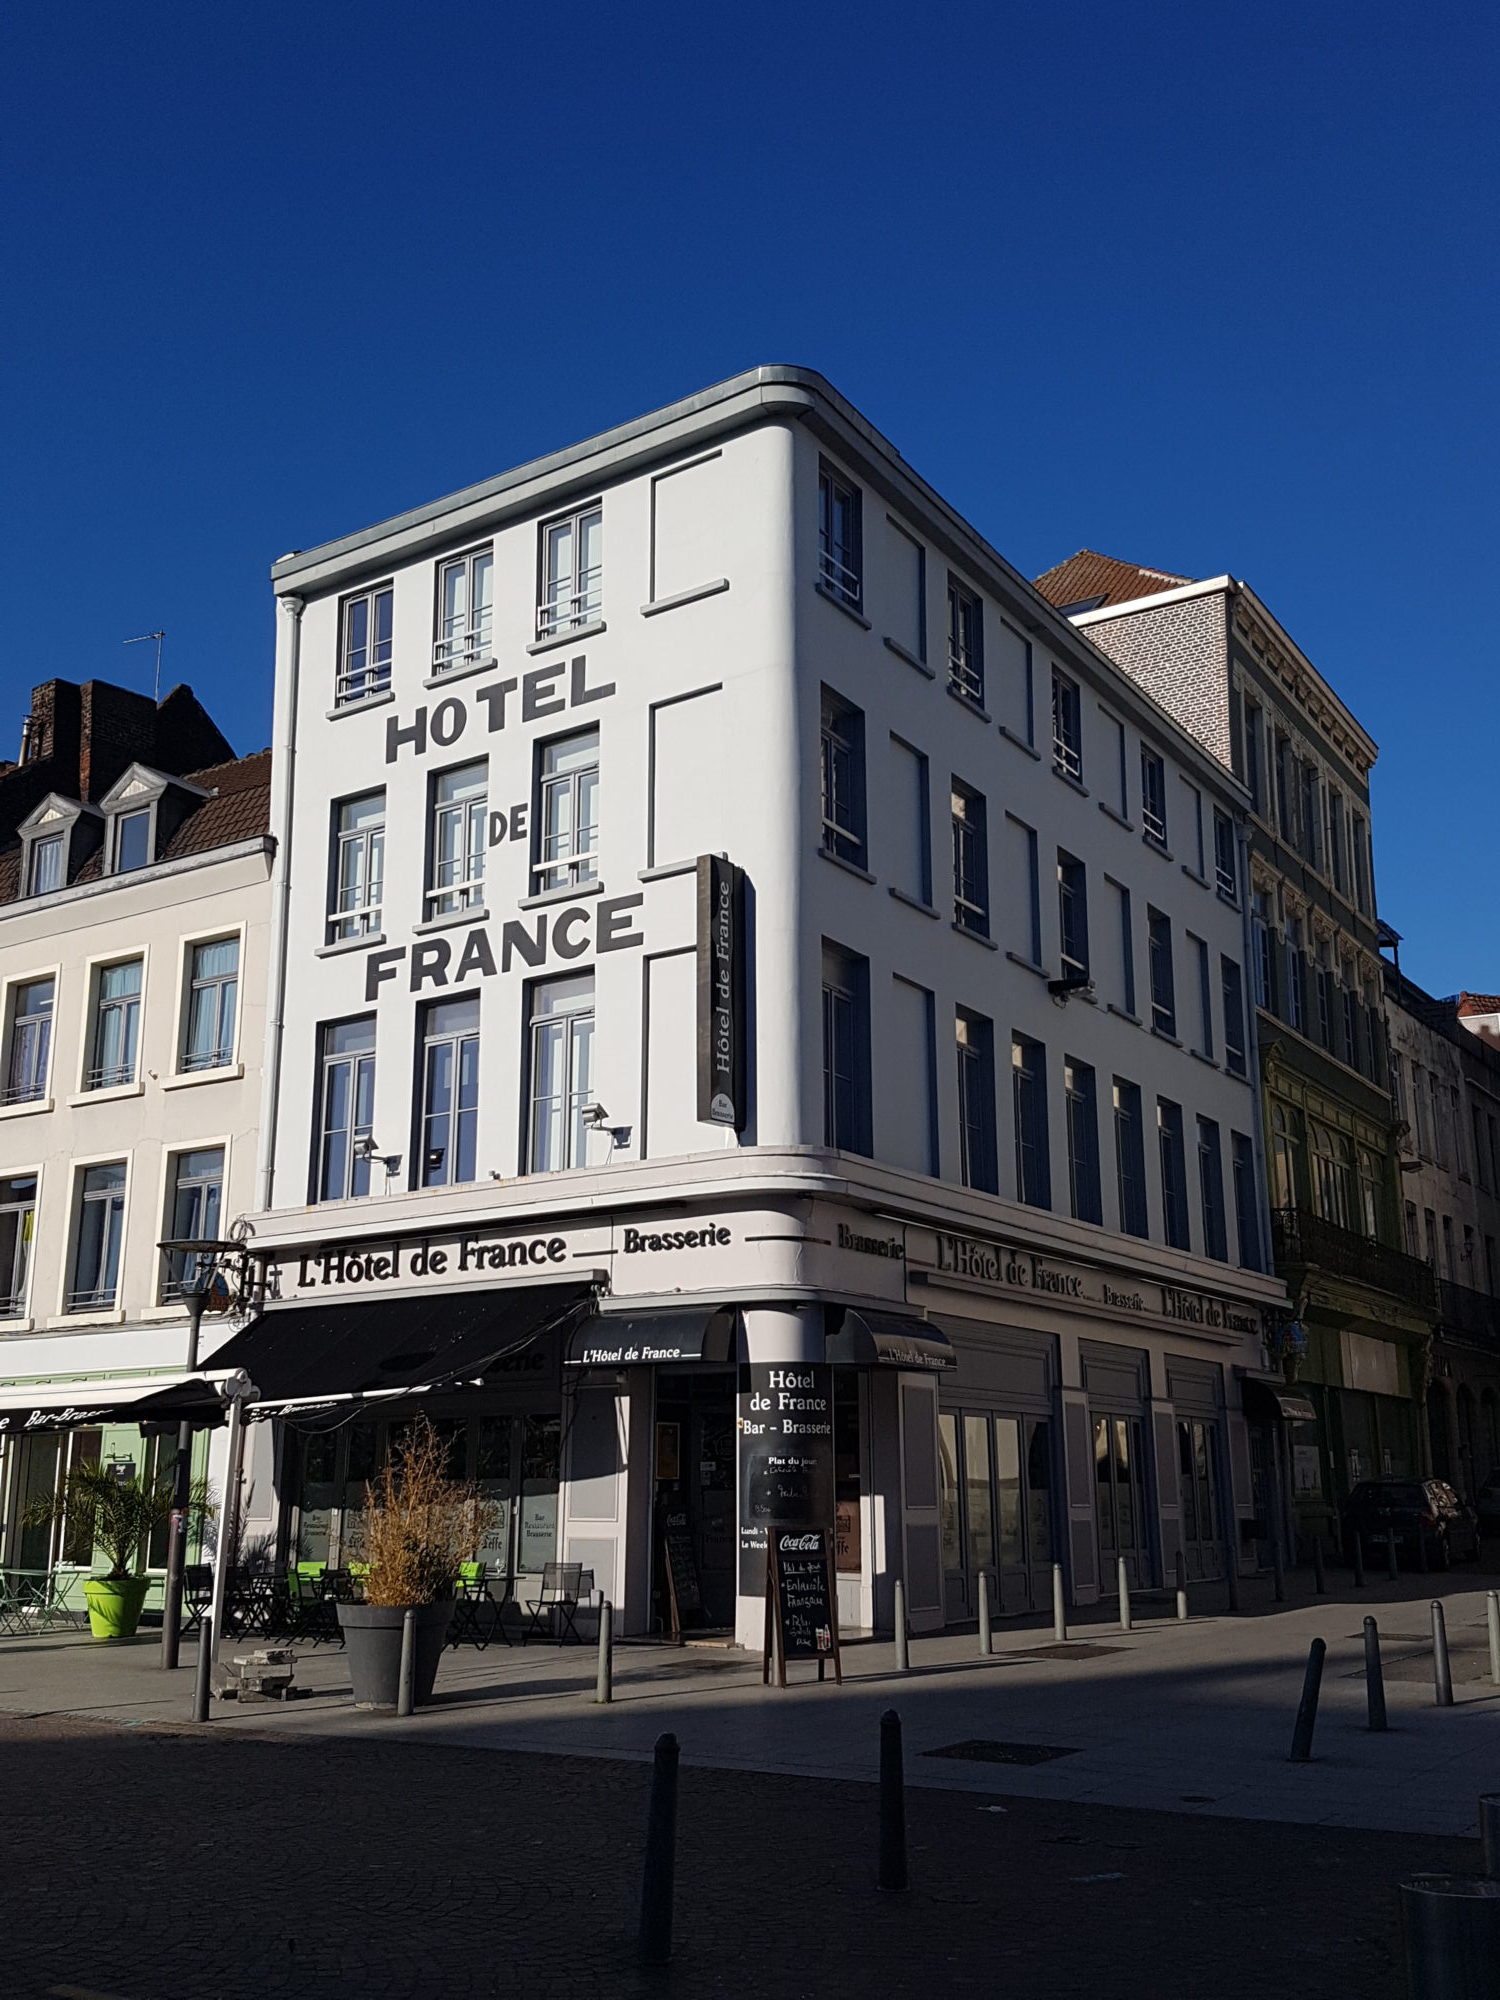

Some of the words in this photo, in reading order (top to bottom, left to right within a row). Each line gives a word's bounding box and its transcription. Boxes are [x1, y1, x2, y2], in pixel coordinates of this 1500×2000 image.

[386, 654, 616, 765] HOTEL
[488, 802, 529, 848] DE
[715, 880, 730, 961] France
[365, 892, 644, 1002] FRANCE
[715, 969, 730, 998] de
[715, 1007, 730, 1074] Hôtel
[622, 1221, 732, 1254] Brasserie
[837, 1222, 905, 1260] Brasserie
[297, 1240, 400, 1289] L'Hôtel
[410, 1239, 448, 1276] de
[457, 1232, 567, 1272] France
[936, 1235, 1003, 1282] L'Hôtel
[1007, 1249, 1029, 1287] de
[1030, 1255, 1084, 1298] France
[582, 1347, 622, 1363] L'Hôtel
[624, 1346, 639, 1360] de
[641, 1346, 681, 1360] France
[768, 1369, 815, 1389] Hôtel
[749, 1391, 772, 1411] de
[778, 1392, 827, 1411] France
[743, 1420, 766, 1435] Bar
[782, 1418, 831, 1435] Brasserie
[768, 1456, 786, 1465] Plat
[788, 1456, 800, 1466] du
[740, 1526, 759, 1536] Lundi
